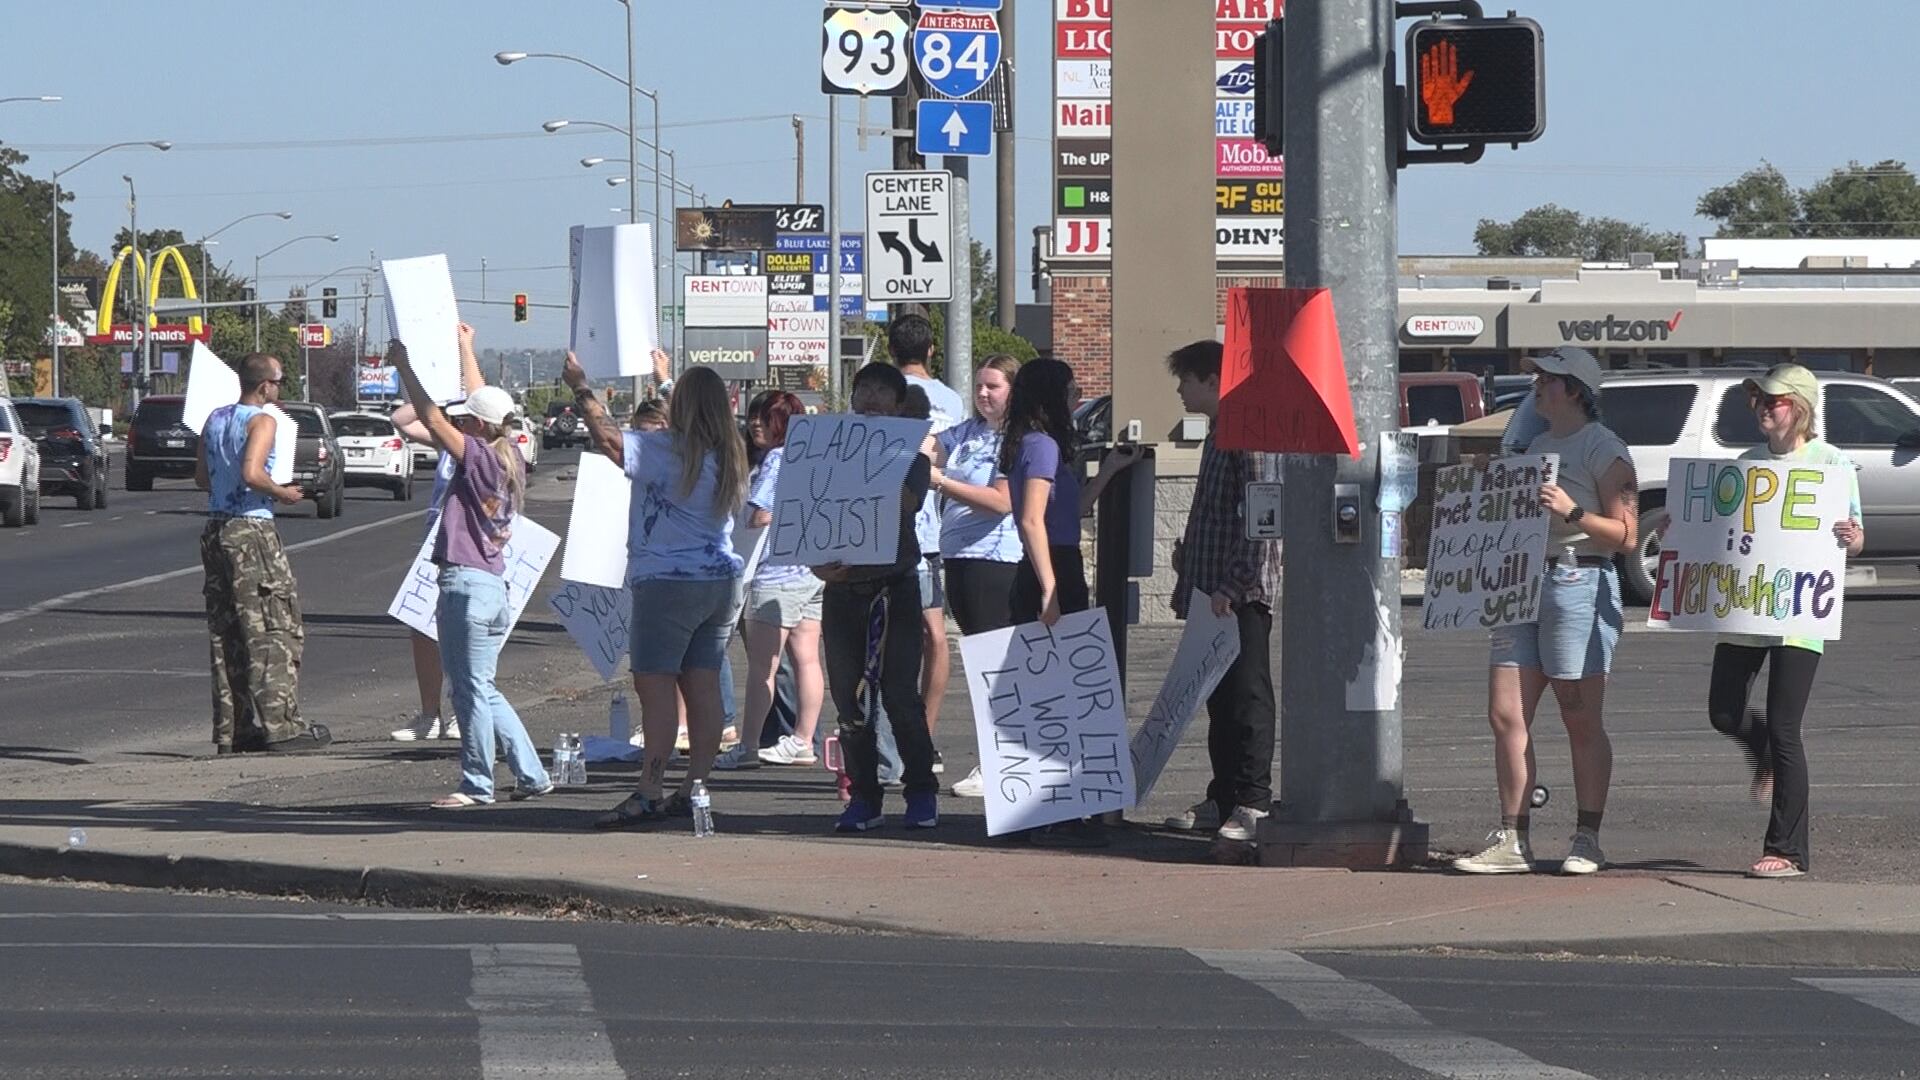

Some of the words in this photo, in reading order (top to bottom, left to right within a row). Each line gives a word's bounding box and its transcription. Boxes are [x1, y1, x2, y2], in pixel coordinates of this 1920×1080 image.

[924, 16, 991, 30] INTERSTATE
[838, 29, 896, 76] 93
[920, 32, 989, 81] 84
[1060, 152, 1087, 166] The
[872, 177, 944, 193] CENTER
[885, 195, 931, 211] LANE
[767, 254, 810, 265] DOLLAR
[783, 239, 805, 248] BLUE
[690, 280, 764, 293] RENTOWN
[770, 282, 806, 290] VAPOR
[773, 274, 802, 282] ELITE
[885, 278, 934, 294] ONLY
[1414, 320, 1476, 331] RENTOWN
[1559, 314, 1670, 342] verizon
[689, 346, 756, 363] verizon
[780, 341, 795, 350] TO
[784, 418, 868, 464] GLAD
[809, 465, 833, 502] U
[1682, 461, 1825, 534] HOPE
[772, 494, 888, 558] EXSIST
[1434, 495, 1473, 530] met
[1477, 489, 1511, 523] all
[1427, 521, 1542, 586] people
[1726, 527, 1754, 556] is
[1430, 567, 1473, 599] you
[1480, 552, 1530, 592] will
[1649, 550, 1836, 621] Everywhere
[1019, 623, 1060, 676] IS
[1060, 617, 1115, 721] YOUR
[980, 666, 1033, 804] LIVING
[1029, 693, 1073, 806] WORTH
[1078, 732, 1124, 805] LIFE
